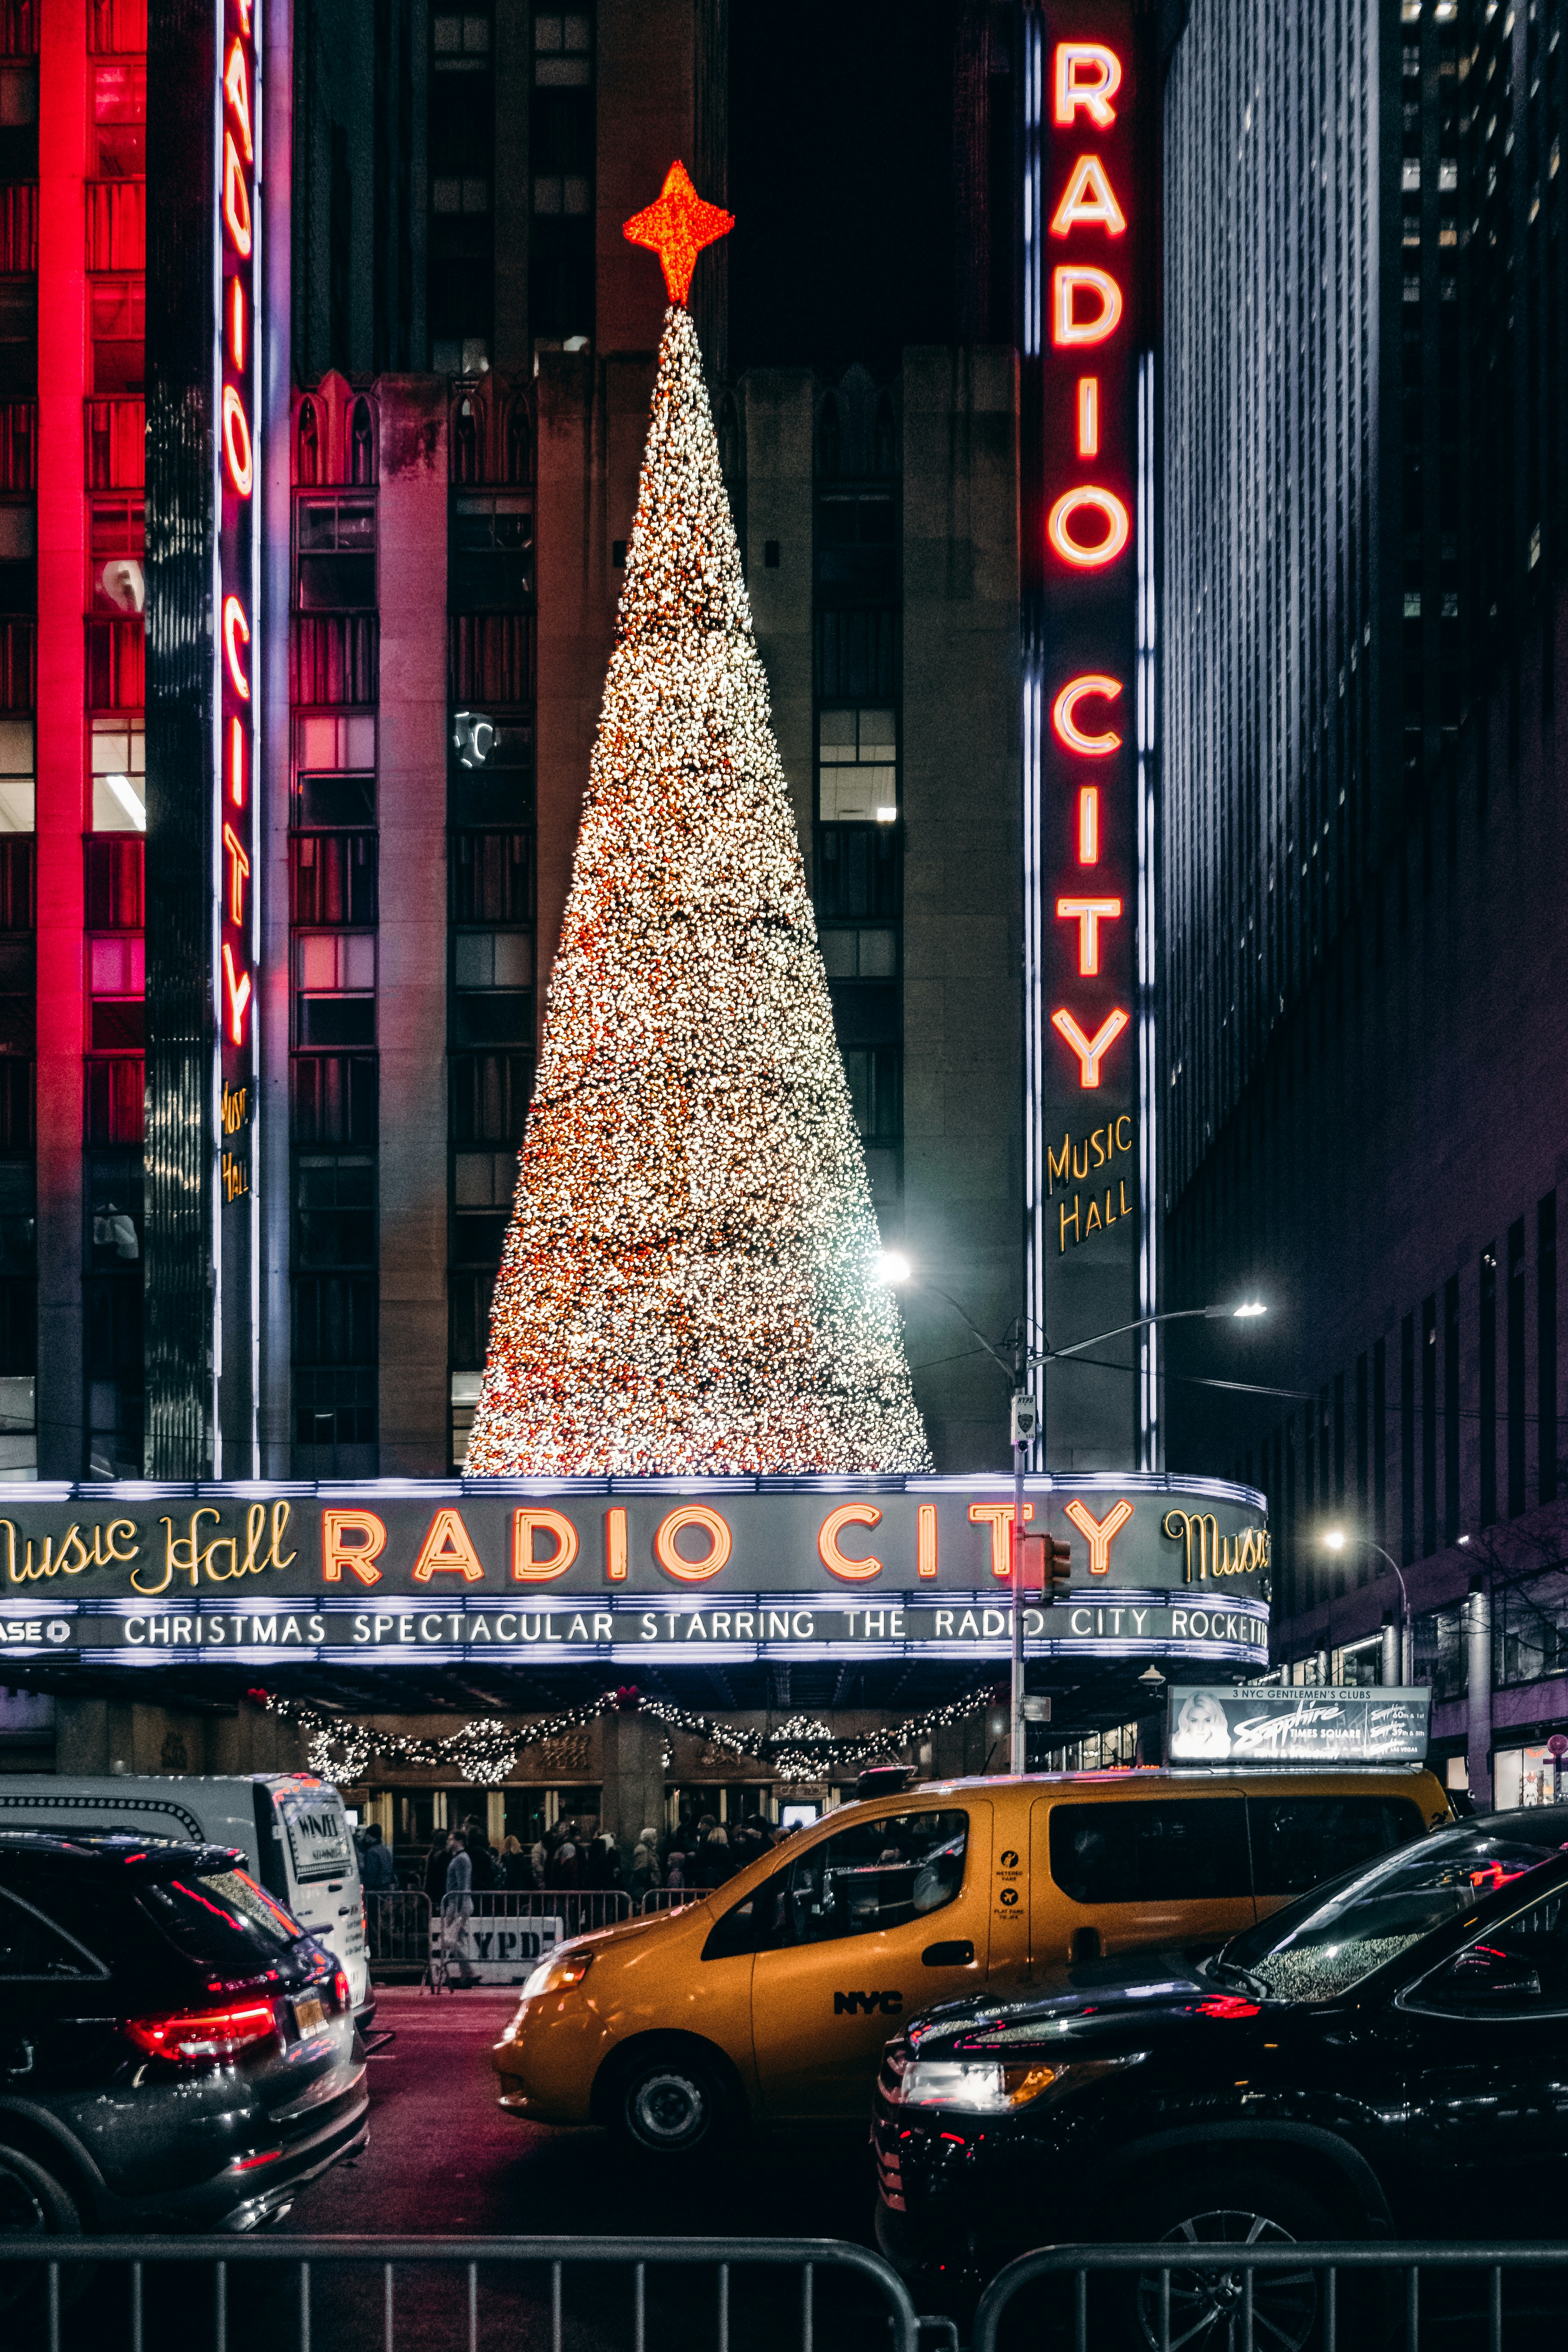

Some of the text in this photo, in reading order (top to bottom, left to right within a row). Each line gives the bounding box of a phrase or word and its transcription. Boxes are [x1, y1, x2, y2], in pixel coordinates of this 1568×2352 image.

[225, 0, 253, 496] ADIO
[1049, 42, 1129, 567] RADIO
[223, 595, 250, 1046] CITY
[1051, 675, 1130, 1089] CITY
[1048, 1115, 1132, 1195] MUSIC
[1060, 1180, 1133, 1252] HALL
[130, 1500, 297, 1594] Hall
[323, 1498, 1134, 1586] RADIO CITY
[125, 1615, 325, 1643] CHRISTMAS
[353, 1612, 613, 1643] SPECTACULAR
[640, 1611, 814, 1641] STARRING
[844, 1610, 905, 1637] THE
[936, 1609, 1044, 1637] RADIO
[1072, 1608, 1148, 1637] CITY
[1232, 1689, 1371, 1699] 3 NYC GENTLEMEN'S CLUBS
[1233, 1699, 1346, 1751] Sapphire
[1291, 1728, 1361, 1738] TIMES SQUARE
[458, 1931, 542, 1959] YPD
[834, 1991, 903, 2014] NYC
